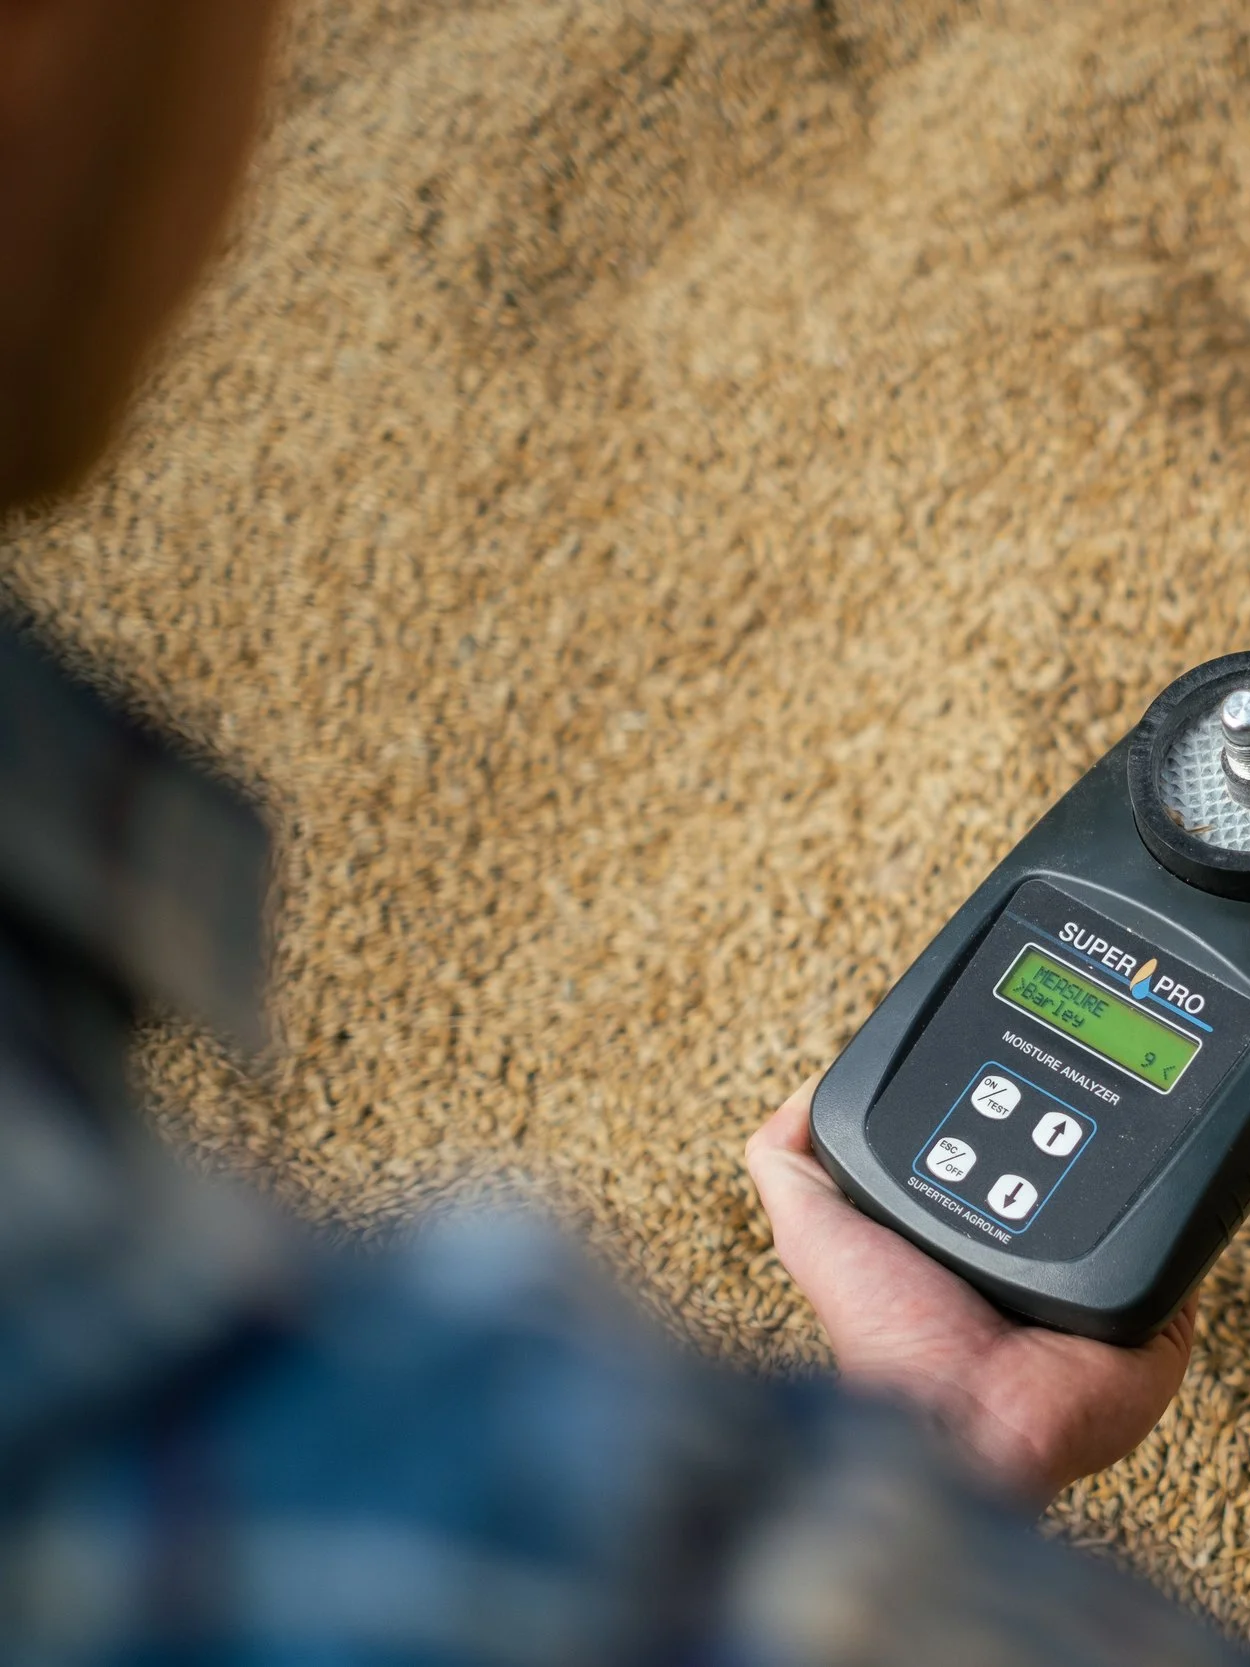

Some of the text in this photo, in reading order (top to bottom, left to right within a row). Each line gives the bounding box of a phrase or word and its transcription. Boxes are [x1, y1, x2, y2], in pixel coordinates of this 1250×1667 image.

[1059, 922, 1205, 1014] SUPER PRO
[1033, 966, 1109, 1018] MEASURE
[1002, 1031, 1121, 1106] MOISTURE ANALYZER
[1140, 1052, 1156, 1068] 9
[984, 1078, 998, 1090] ON
[987, 1099, 1009, 1116] TEST
[939, 1139, 958, 1154] ESC
[945, 1163, 964, 1178] OFF
[907, 1176, 1012, 1245] SUPERTECH AGROLINE
